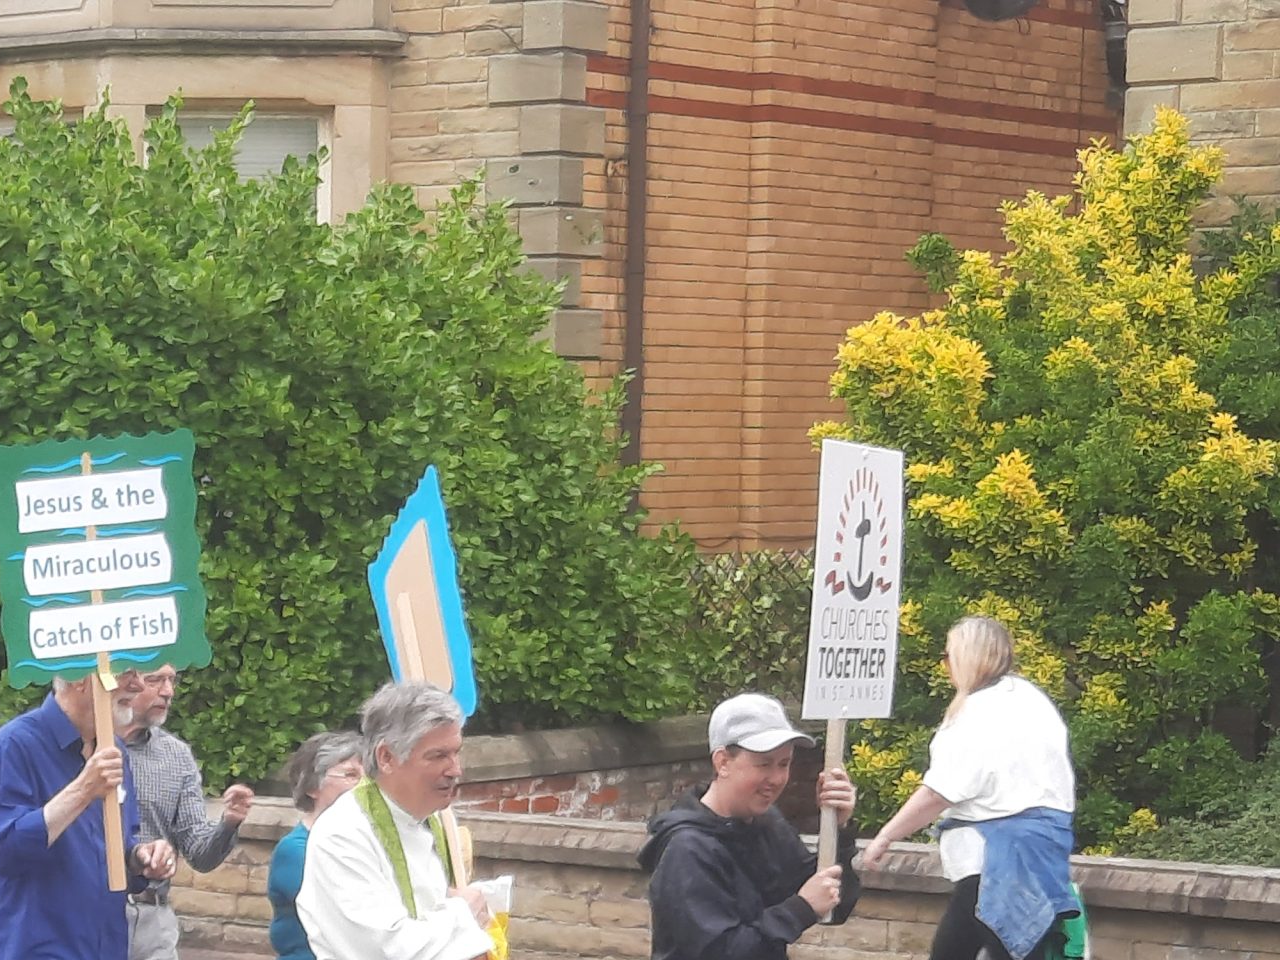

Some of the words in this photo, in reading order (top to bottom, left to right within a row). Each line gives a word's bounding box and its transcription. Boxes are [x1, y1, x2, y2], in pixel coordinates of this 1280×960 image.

[23, 494, 83, 517] Jesus
[90, 487, 109, 510] &
[116, 484, 155, 506] the
[32, 548, 161, 580] Miraculous
[33, 622, 92, 649] Catch
[100, 617, 122, 641] of
[129, 611, 174, 637] Fish
[821, 606, 889, 641] CHURCHES
[818, 646, 886, 679] TOGETHER
